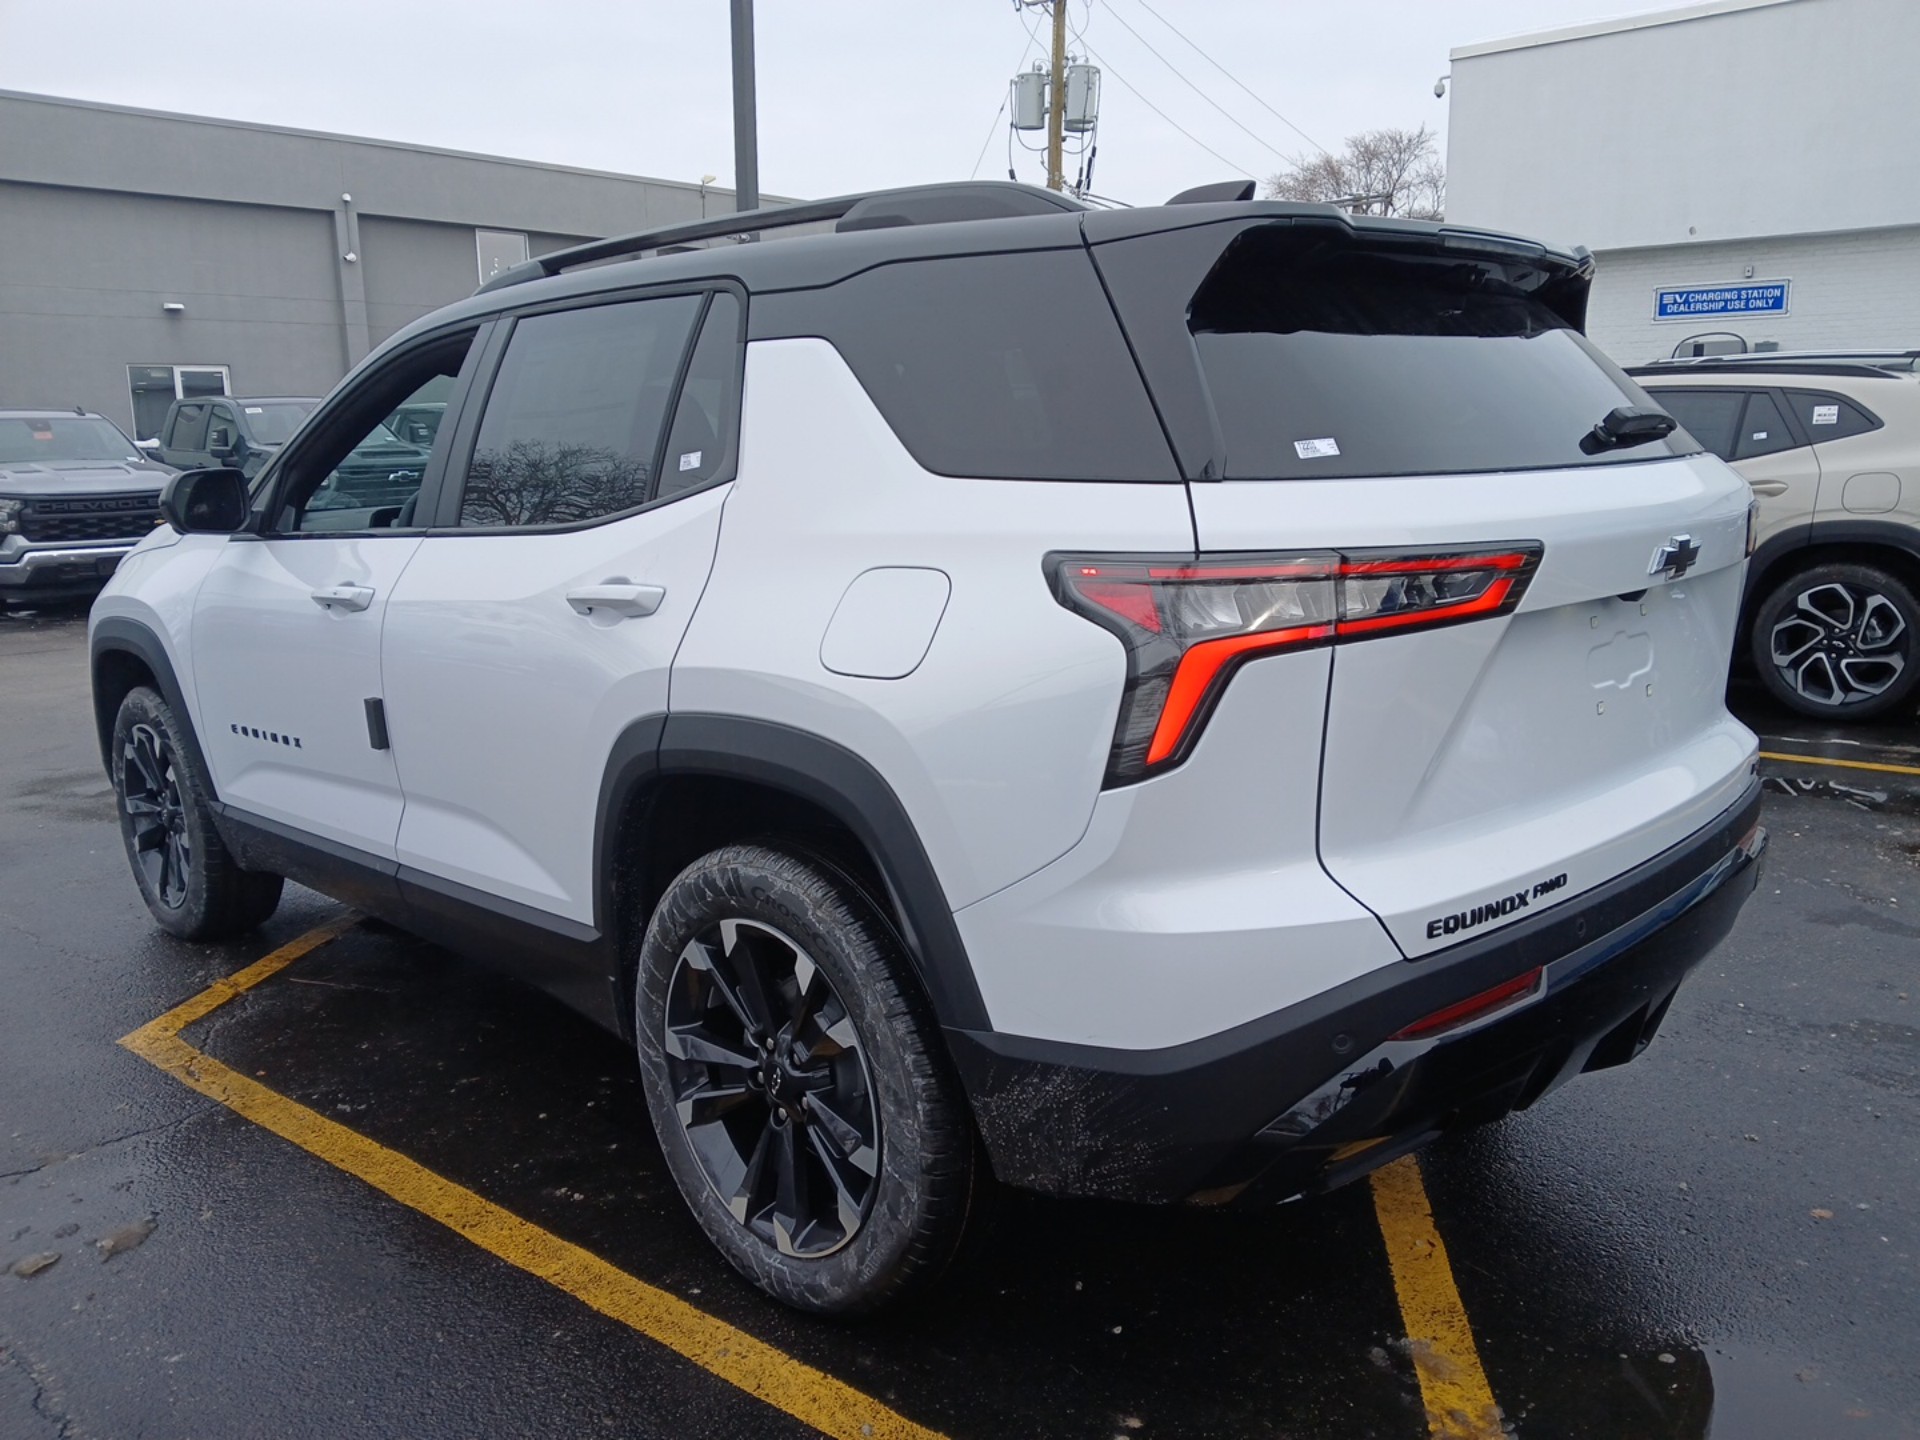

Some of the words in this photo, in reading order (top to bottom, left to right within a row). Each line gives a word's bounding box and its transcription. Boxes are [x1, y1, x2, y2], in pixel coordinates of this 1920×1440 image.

[1662, 293, 1688, 304] EV
[1689, 290, 1738, 302] CHARGING
[1741, 288, 1781, 299] STATION
[1667, 301, 1725, 313] DEALERSHIP
[1728, 300, 1746, 310] USE
[1749, 298, 1774, 309] ONLY
[36, 498, 159, 512] CHEVROLE
[231, 723, 302, 749] EQUINOX
[1427, 889, 1530, 939] EQUINOX
[1533, 873, 1568, 899] AWD
